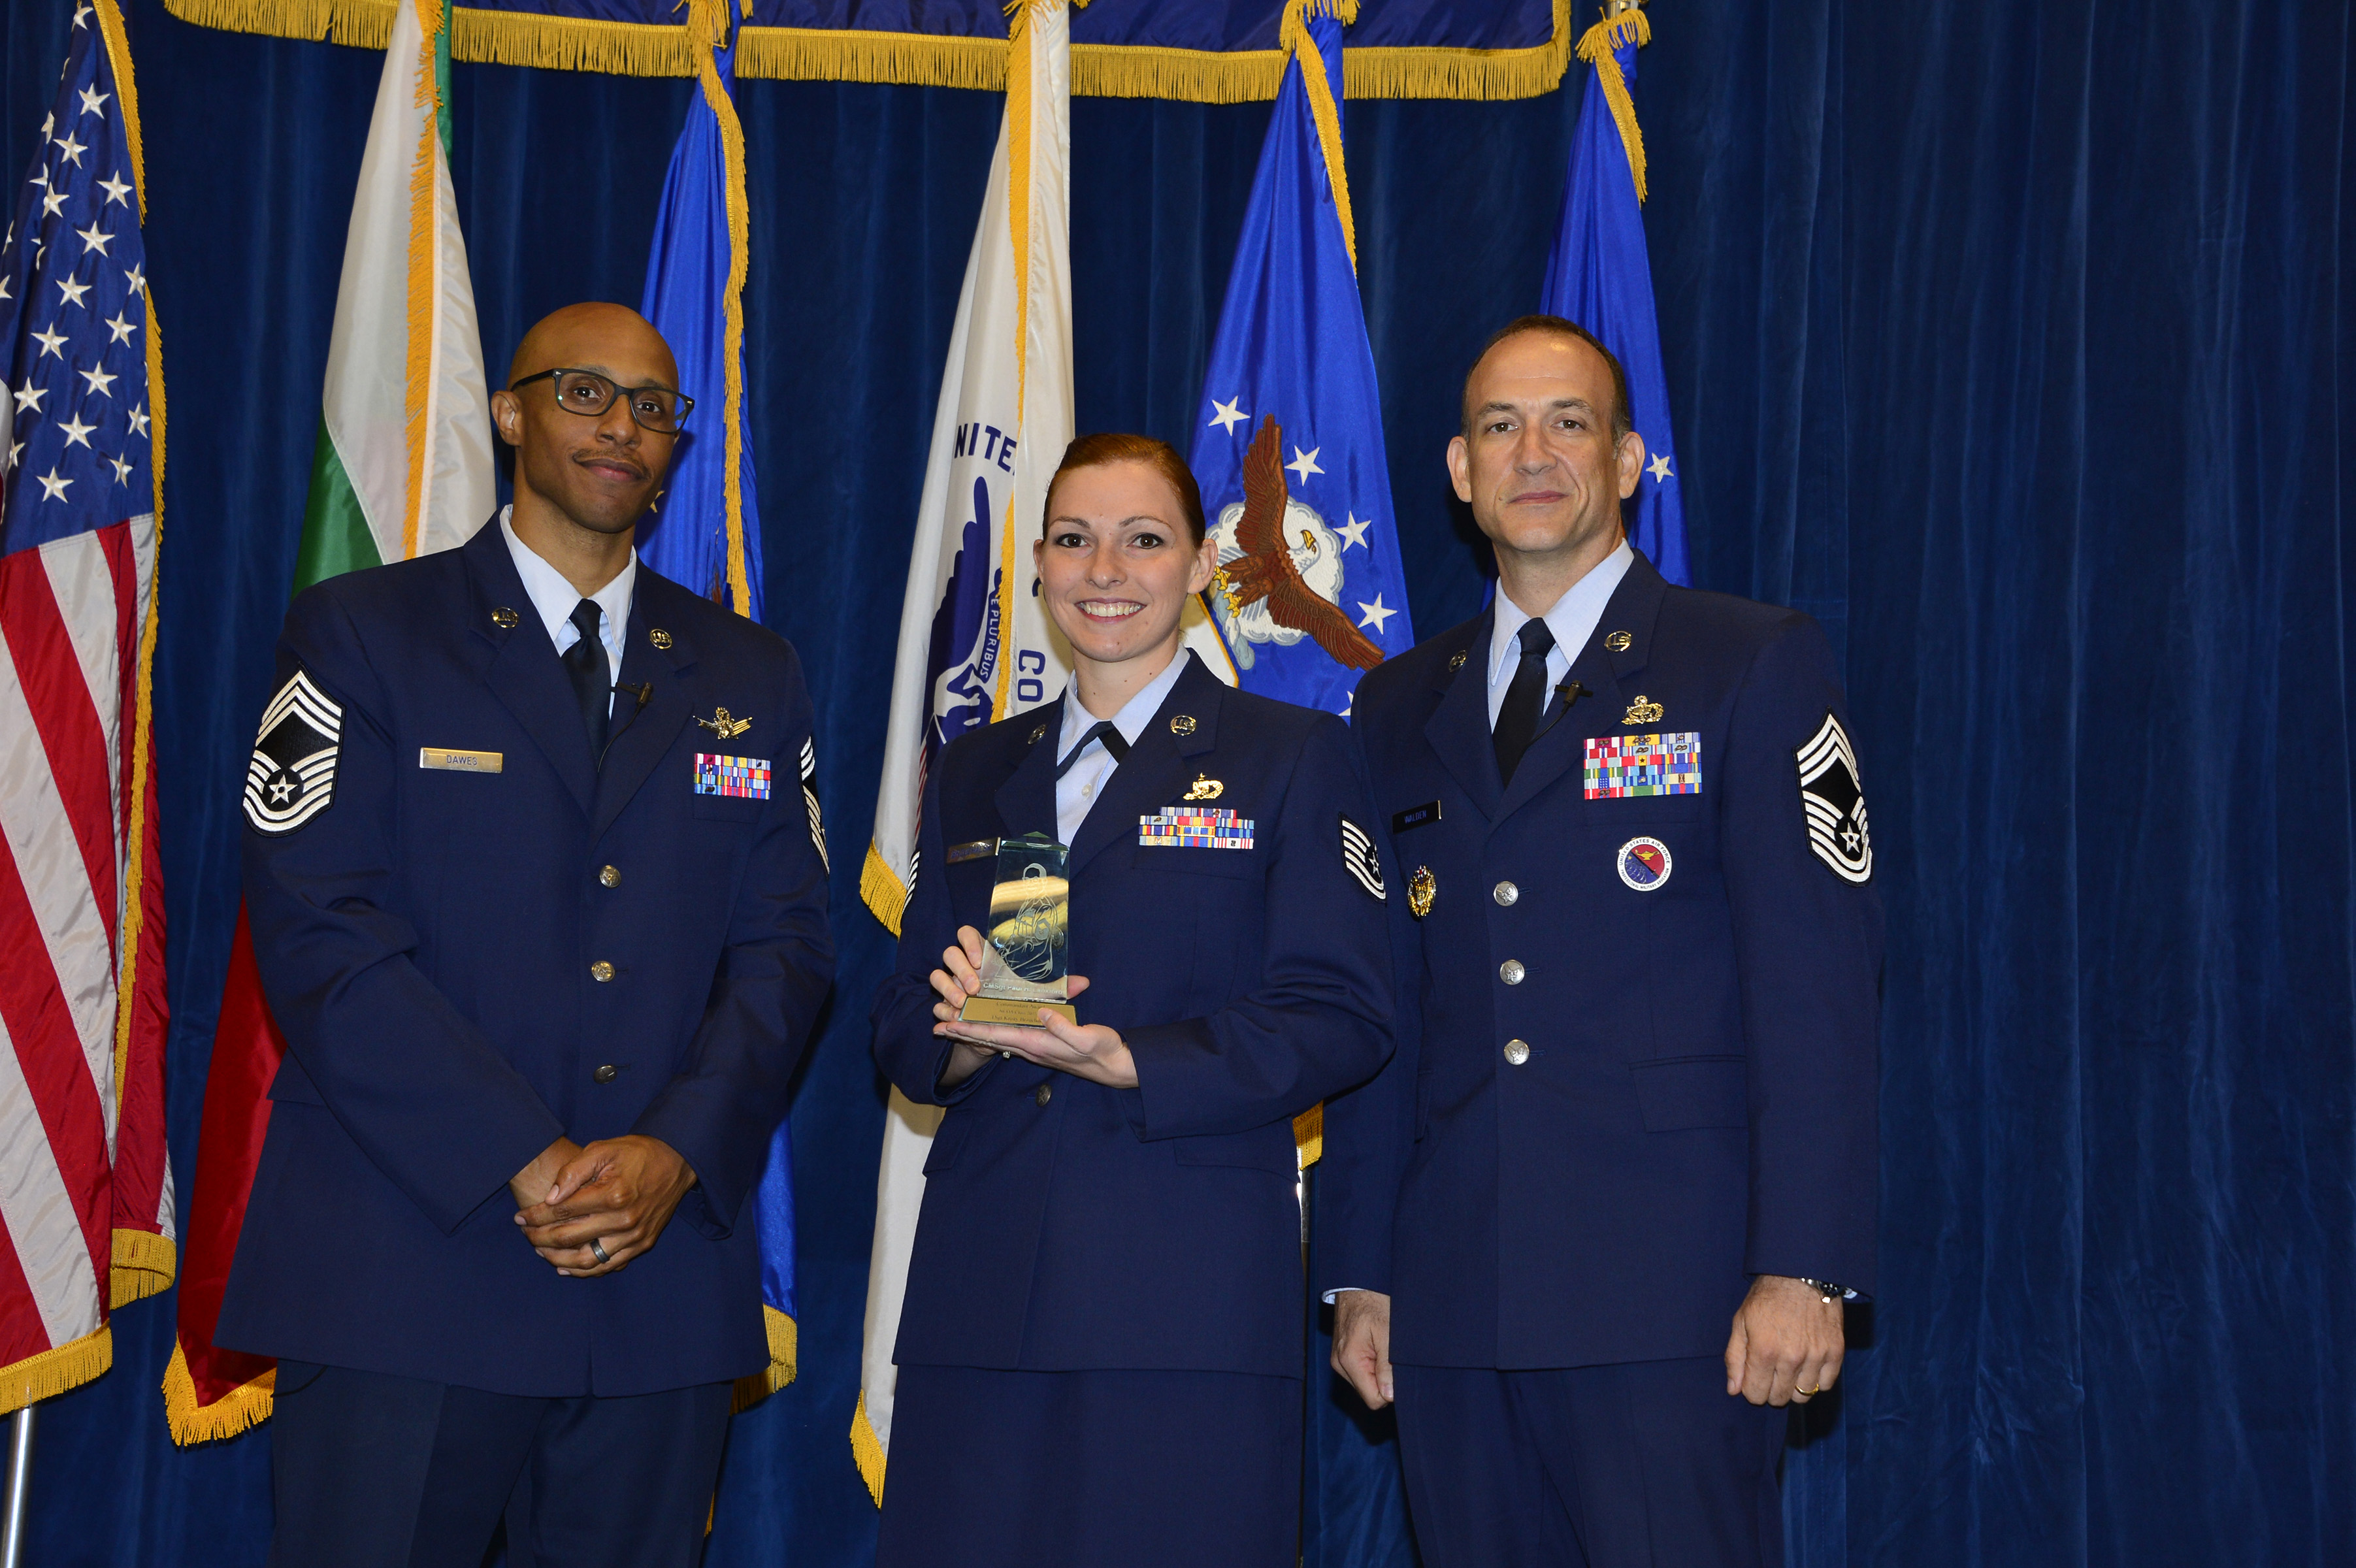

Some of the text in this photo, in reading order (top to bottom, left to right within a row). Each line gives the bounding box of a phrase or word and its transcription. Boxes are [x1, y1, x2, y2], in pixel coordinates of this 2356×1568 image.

[955, 423, 1017, 476] NITE
[980, 610, 999, 678] PLURIBUS
[446, 755, 478, 766] DAWES
[1404, 810, 1427, 824] WALDEN
[1619, 847, 1629, 866] UNITED
[1629, 838, 1650, 847] STATES
[1660, 847, 1671, 864] FORCE
[983, 982, 1006, 992] CMSgt
